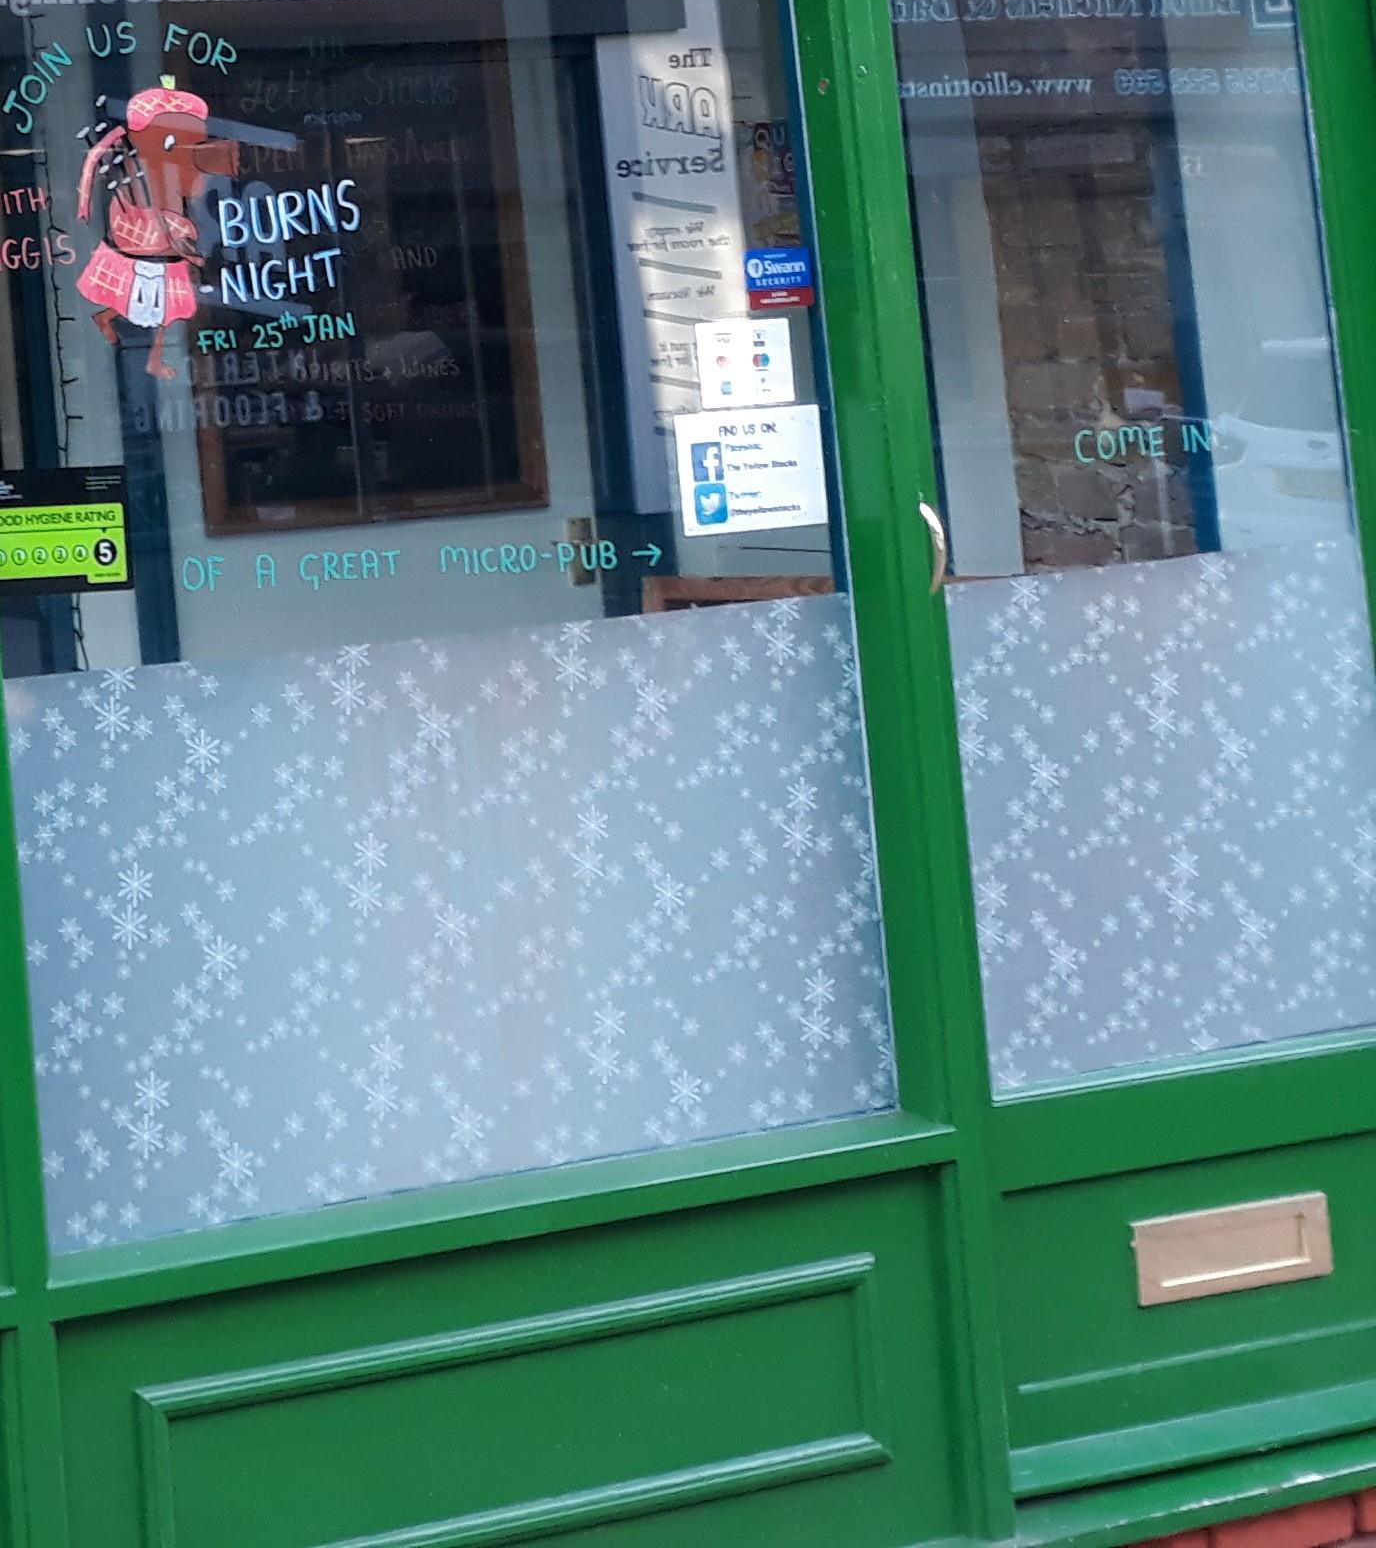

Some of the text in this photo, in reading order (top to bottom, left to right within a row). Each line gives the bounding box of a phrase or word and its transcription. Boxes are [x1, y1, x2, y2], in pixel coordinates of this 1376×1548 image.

[2, 21, 237, 135] JOIN US FOR
[217, 180, 361, 248] BURNS
[220, 248, 342, 305] NIGHT
[764, 260, 806, 274] Swann
[197, 311, 355, 354] FRI 25th JAN
[743, 424, 756, 435] US
[1074, 425, 1164, 463] COME
[25, 513, 74, 526] HYGIENE
[75, 510, 116, 523] RATING
[98, 541, 113, 564] 5
[182, 541, 619, 592] OF A GREAT MICRO-PUB
